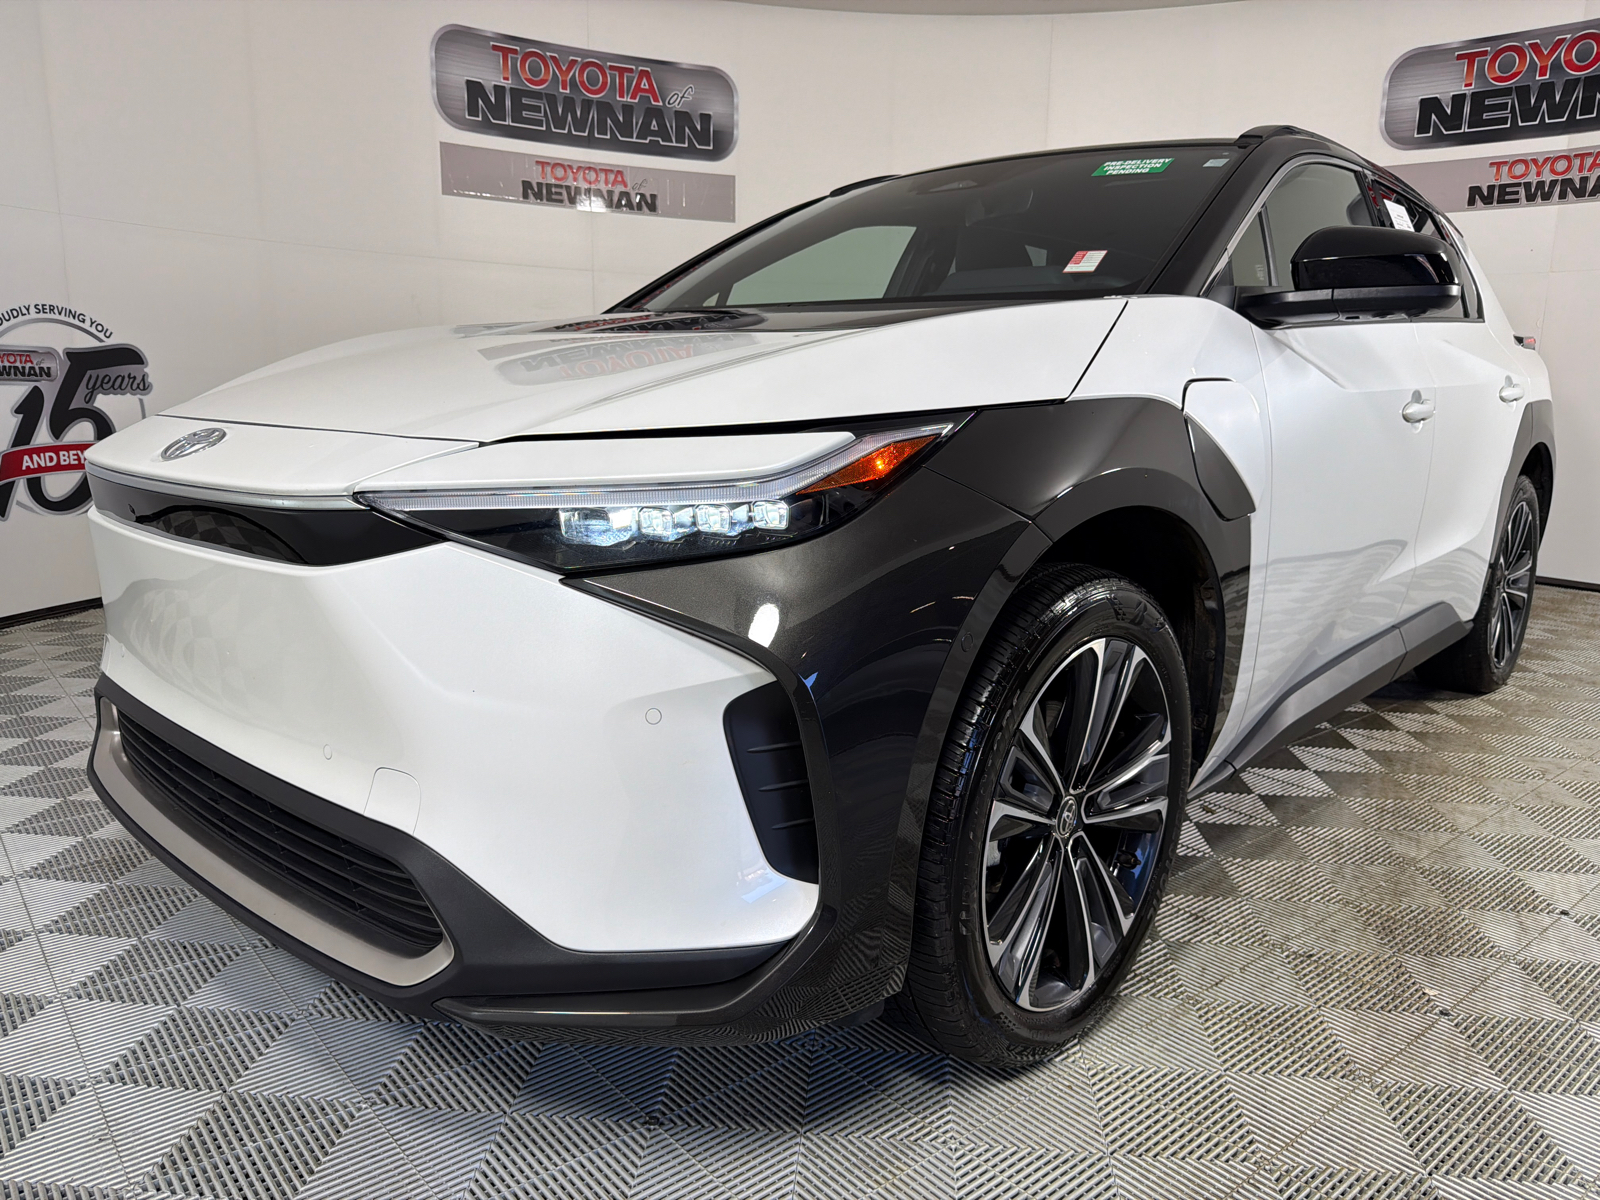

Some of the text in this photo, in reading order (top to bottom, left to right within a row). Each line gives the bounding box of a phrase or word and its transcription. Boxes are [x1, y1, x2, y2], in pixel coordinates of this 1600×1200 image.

[490, 42, 694, 108] TOYOTA of
[465, 78, 714, 150] NEWNAN
[535, 160, 648, 191] TOYOTA of
[1104, 157, 1173, 167] PRE-DELIVERY
[1104, 163, 1162, 171] INSPECTION
[521, 180, 658, 212] NEWNAN
[33, 303, 87, 324] SERVING
[89, 316, 113, 339] YOU
[85, 372, 150, 405] years
[22, 452, 57, 470] AND
